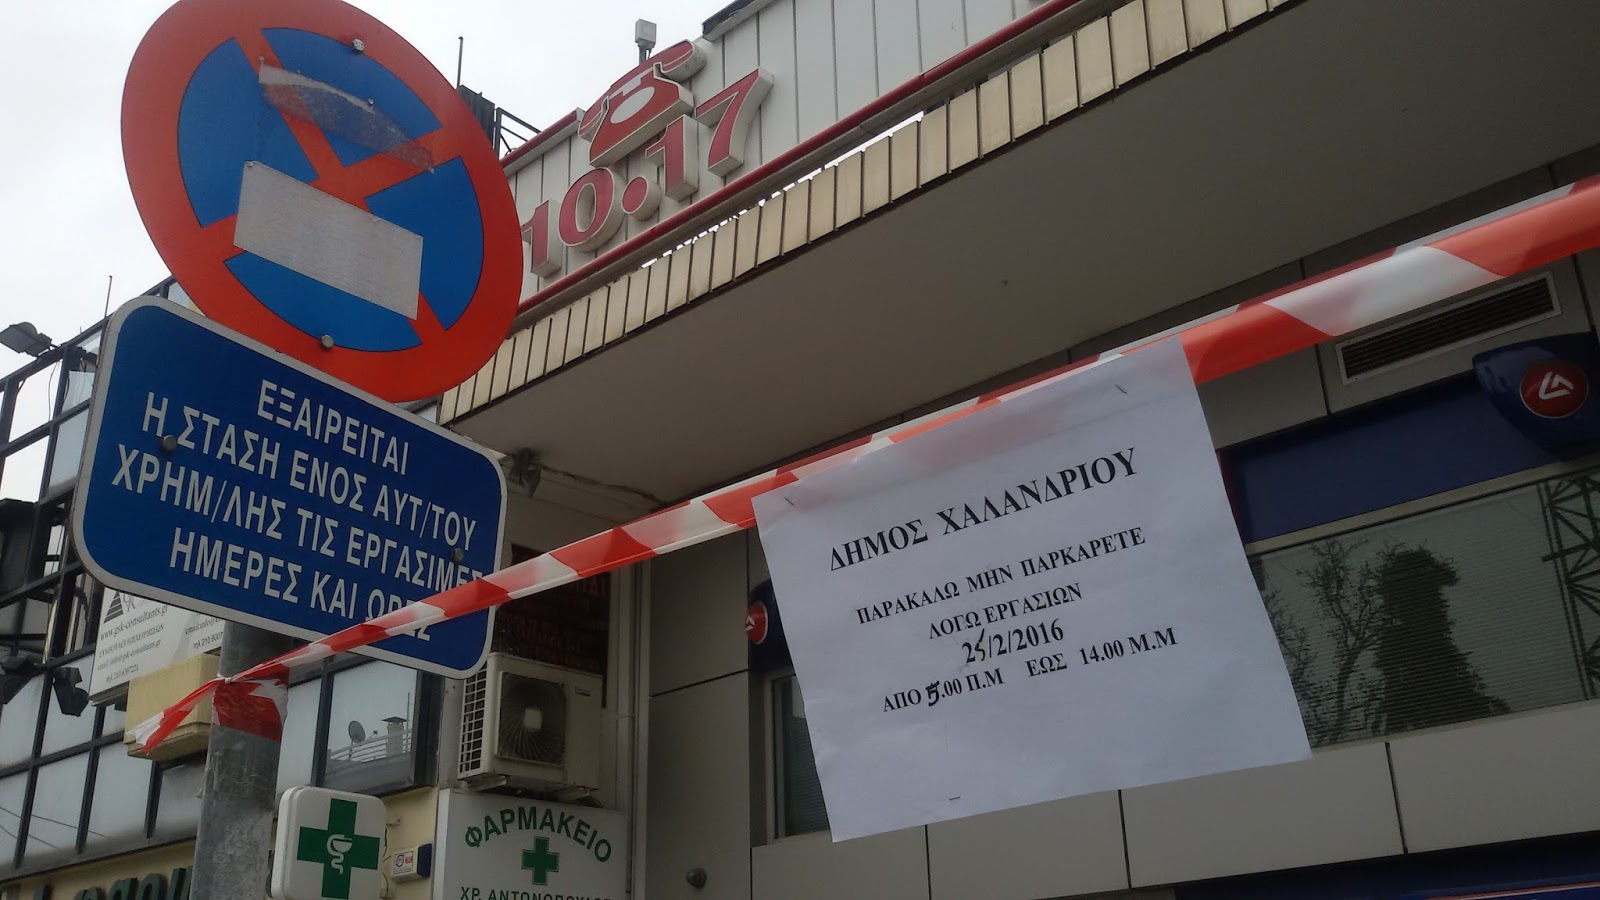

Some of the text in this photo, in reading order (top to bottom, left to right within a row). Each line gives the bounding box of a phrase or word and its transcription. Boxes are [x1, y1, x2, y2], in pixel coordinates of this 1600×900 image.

[142, 391, 477, 550] Η ΣΤΑΣΗ ΕΝΟΣ ΑΥΤ/ΤΟΥ
[257, 379, 409, 475] ΕΞΑΙΡΕΙΤΑΙ
[111, 443, 287, 540] ΧΡΗΜ/ΛΗΣ
[297, 507, 339, 557] ΤΙΣ
[830, 447, 1138, 571] ΔΗΜΟΣ ΧΑΛΑΝΔΡΙΟΥ
[169, 527, 303, 604] ΗΜΕΡΕΣ
[310, 571, 358, 619] ΚΑΙ
[856, 527, 1146, 624] ΠΑΡΑΚΑΛΩ ΜΗΝ ΠΑΡΚΑΡΕΤΕ
[928, 582, 1084, 640] ΛΟΓΩ ΕΡΓΑΣΙΩΝ
[882, 688, 922, 713] ΑΠΟ
[964, 667, 1005, 693] Π.Μ
[1025, 653, 1068, 678] ΕΩΣ
[1078, 639, 1125, 666] 14.00
[1127, 626, 1179, 654] Μ.Μ
[465, 806, 612, 863] ΦΑΡΜΑΚΕΙΟ
